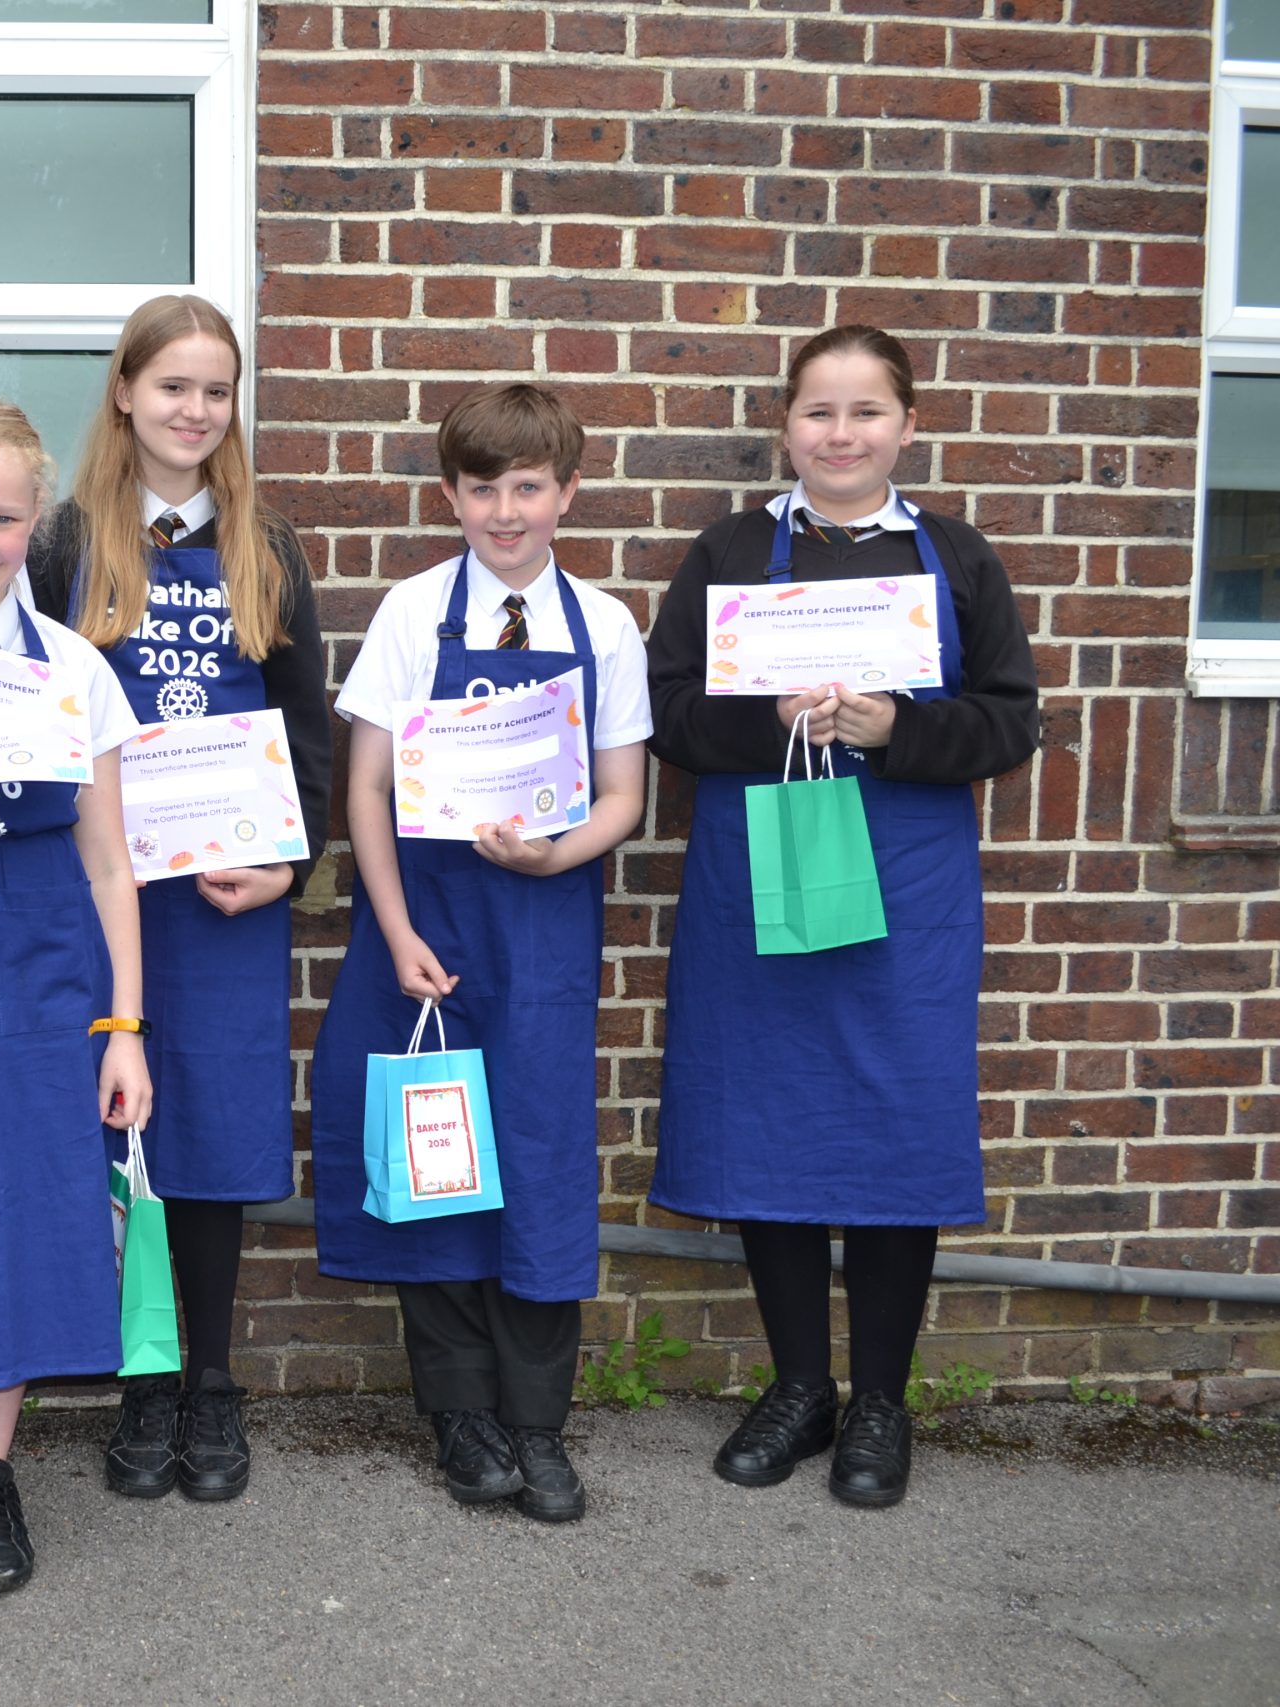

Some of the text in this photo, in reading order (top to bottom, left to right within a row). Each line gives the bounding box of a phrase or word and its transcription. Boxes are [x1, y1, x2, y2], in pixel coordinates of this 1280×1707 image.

[744, 610, 804, 618] CERTIFICATE
[823, 604, 890, 614] ACHIEVEMENT
[189, 614, 234, 644] Of
[138, 647, 220, 678] 2026
[429, 724, 487, 734] CERTIFICATE
[504, 707, 556, 728] ACHIEVEMENT
[170, 748, 182, 756] OF
[186, 741, 247, 754] ACHIEVEMENT
[154, 764, 187, 774] certificate
[189, 760, 218, 768] awarded
[150, 802, 184, 813] Competed
[160, 814, 188, 823] Oathall
[190, 810, 208, 819] Bake
[442, 1121, 456, 1130] OFF
[428, 1138, 450, 1148] 2026
